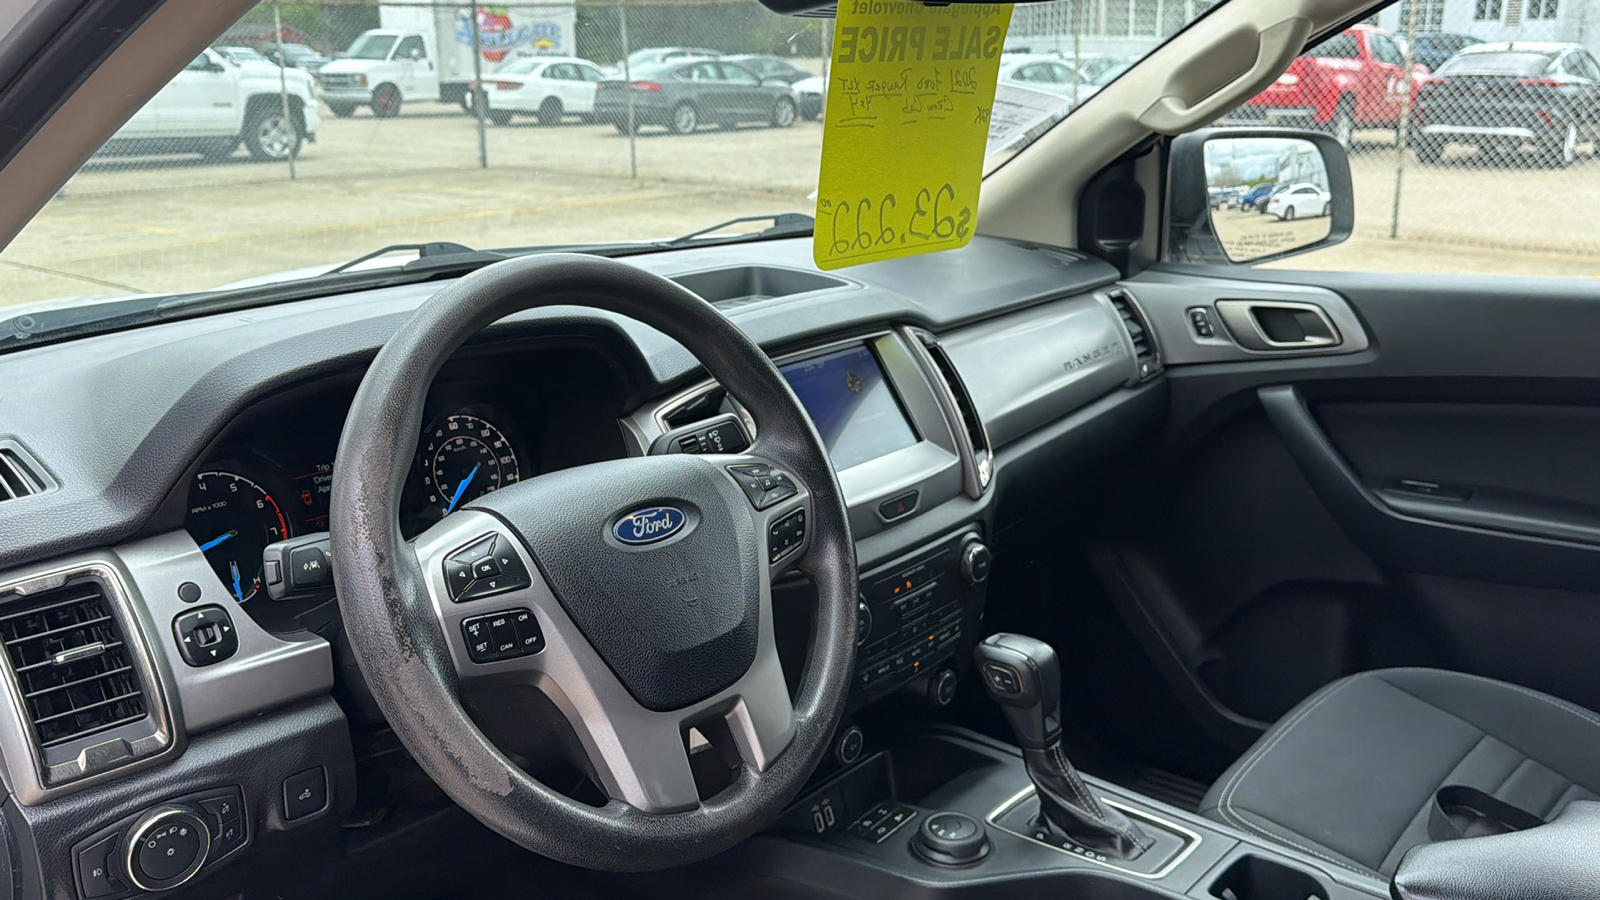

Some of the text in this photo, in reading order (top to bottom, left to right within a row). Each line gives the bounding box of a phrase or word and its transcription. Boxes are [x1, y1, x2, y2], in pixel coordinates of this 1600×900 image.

[315, 464, 331, 472] Trip
[198, 482, 208, 491] 4
[229, 482, 238, 492] 5
[191, 505, 207, 515] RPM
[211, 500, 227, 510] 1000
[256, 500, 264, 509] 6
[633, 511, 673, 537] Ford
[269, 526, 279, 536] 7
[481, 564, 492, 572] OK
[518, 613, 529, 622] ON
[468, 622, 480, 633] SET
[492, 618, 506, 628] RES
[525, 636, 537, 645] OFF
[476, 641, 488, 652] SET
[500, 642, 514, 651] CAN
